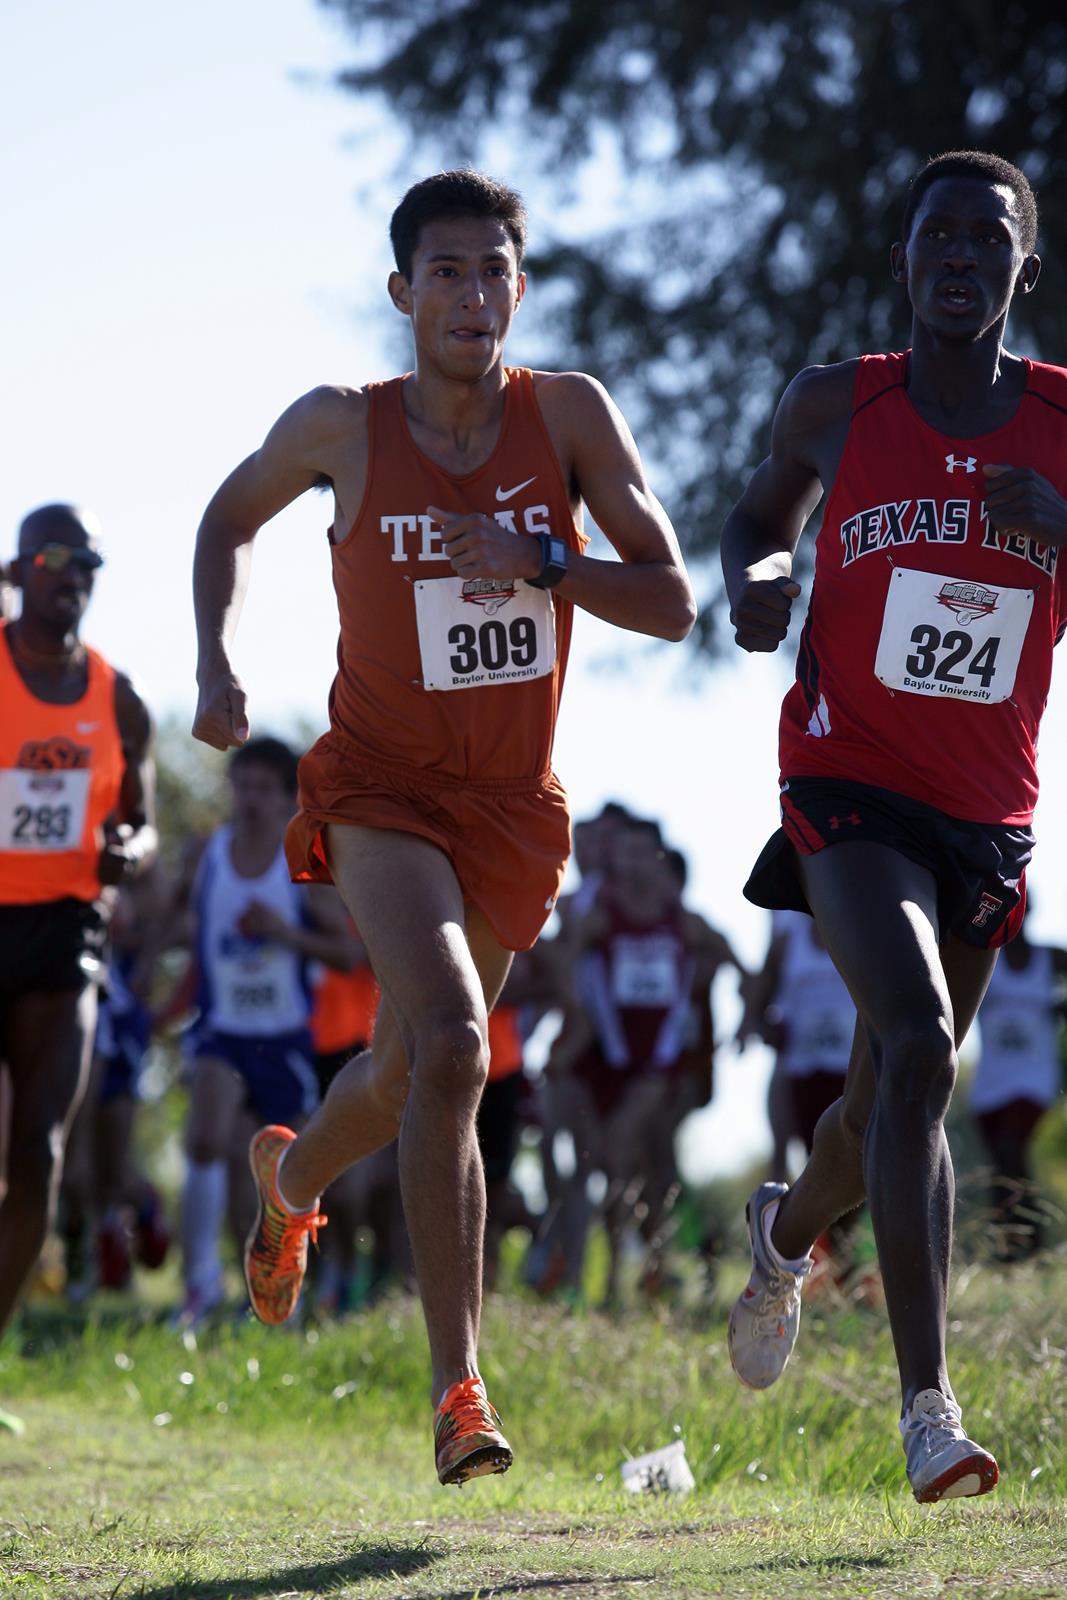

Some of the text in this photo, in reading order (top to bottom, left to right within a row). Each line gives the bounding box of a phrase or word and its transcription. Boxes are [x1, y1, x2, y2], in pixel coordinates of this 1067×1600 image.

[381, 504, 551, 562] TES
[841, 499, 971, 568] TEXAS
[941, 584, 976, 600] BIG
[448, 616, 538, 675] 309
[905, 624, 1001, 688] 324
[452, 667, 539, 686] Baylor University
[903, 677, 991, 700] Baylor University
